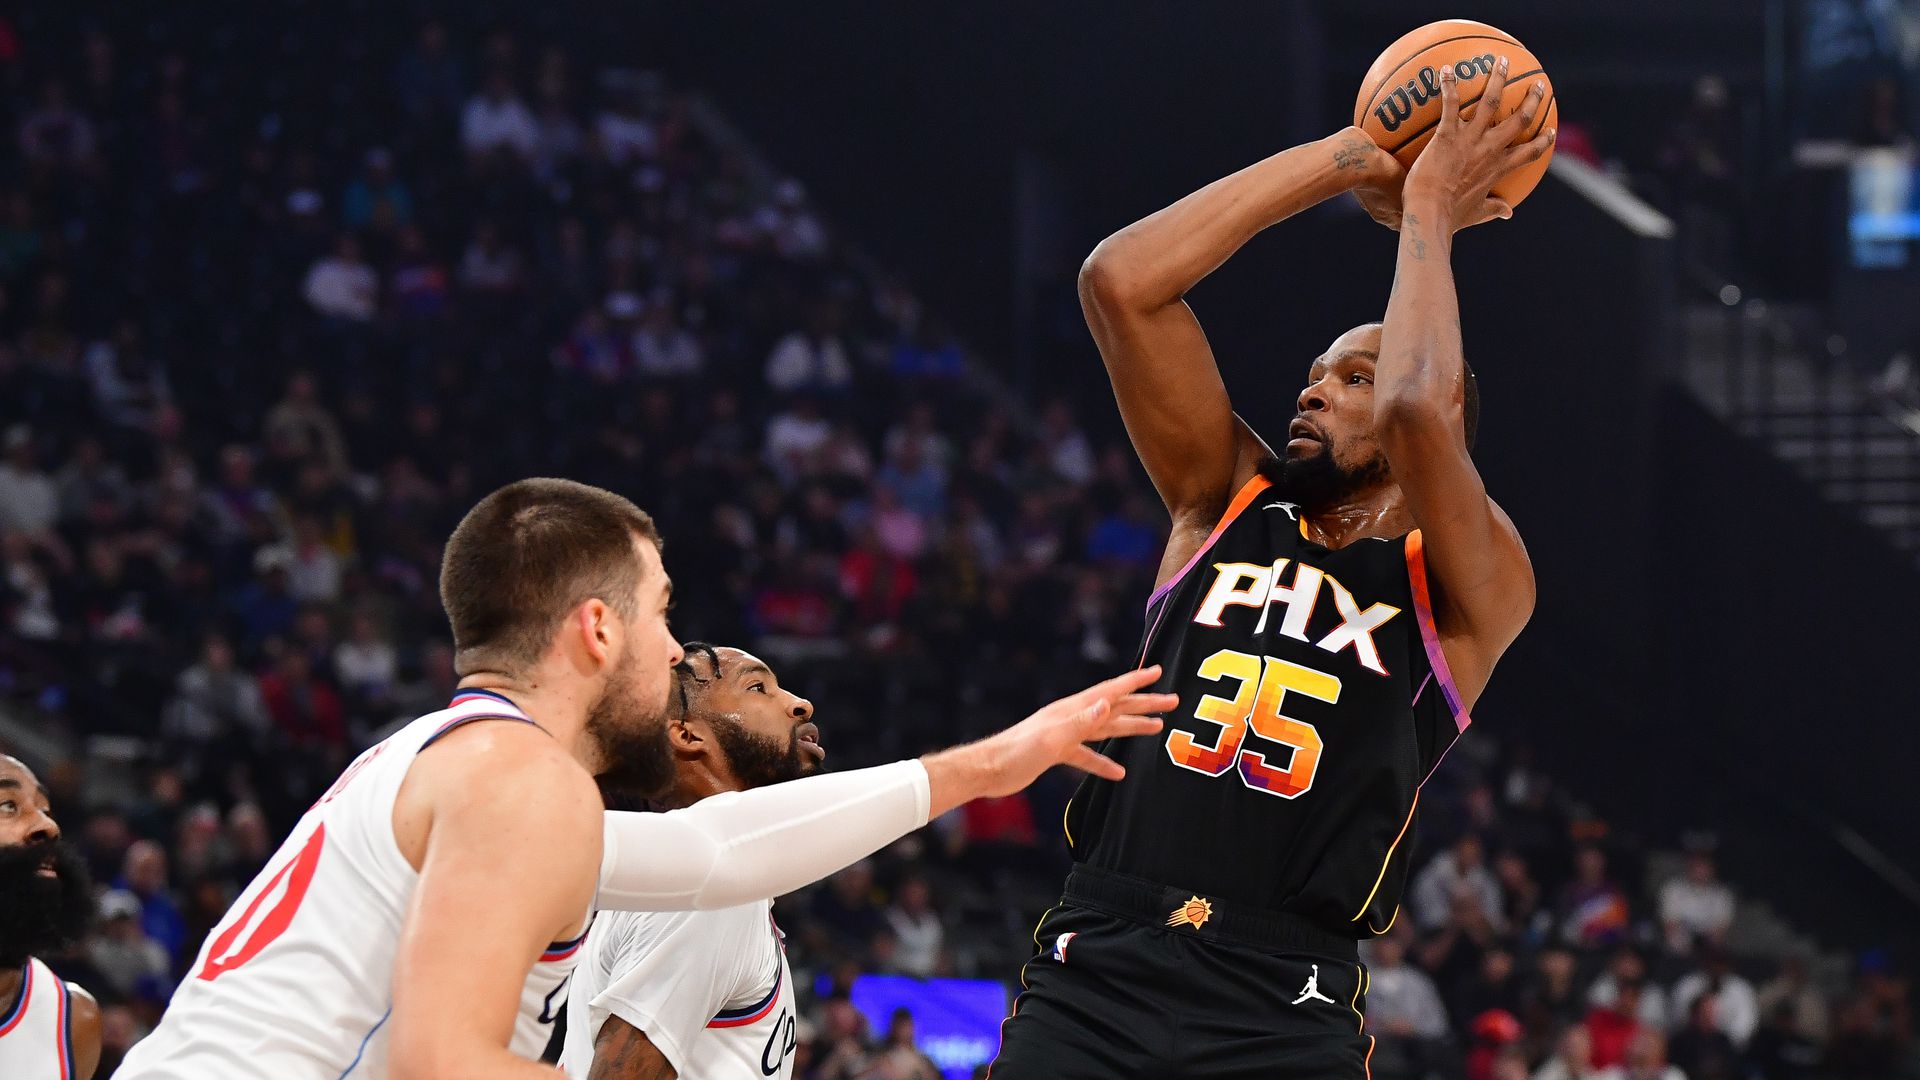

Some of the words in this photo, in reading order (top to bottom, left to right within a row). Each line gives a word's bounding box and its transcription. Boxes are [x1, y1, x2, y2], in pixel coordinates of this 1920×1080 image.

[1374, 54, 1497, 133] Wilon
[1193, 557, 1403, 678] PHX
[1165, 649, 1343, 801] 35
